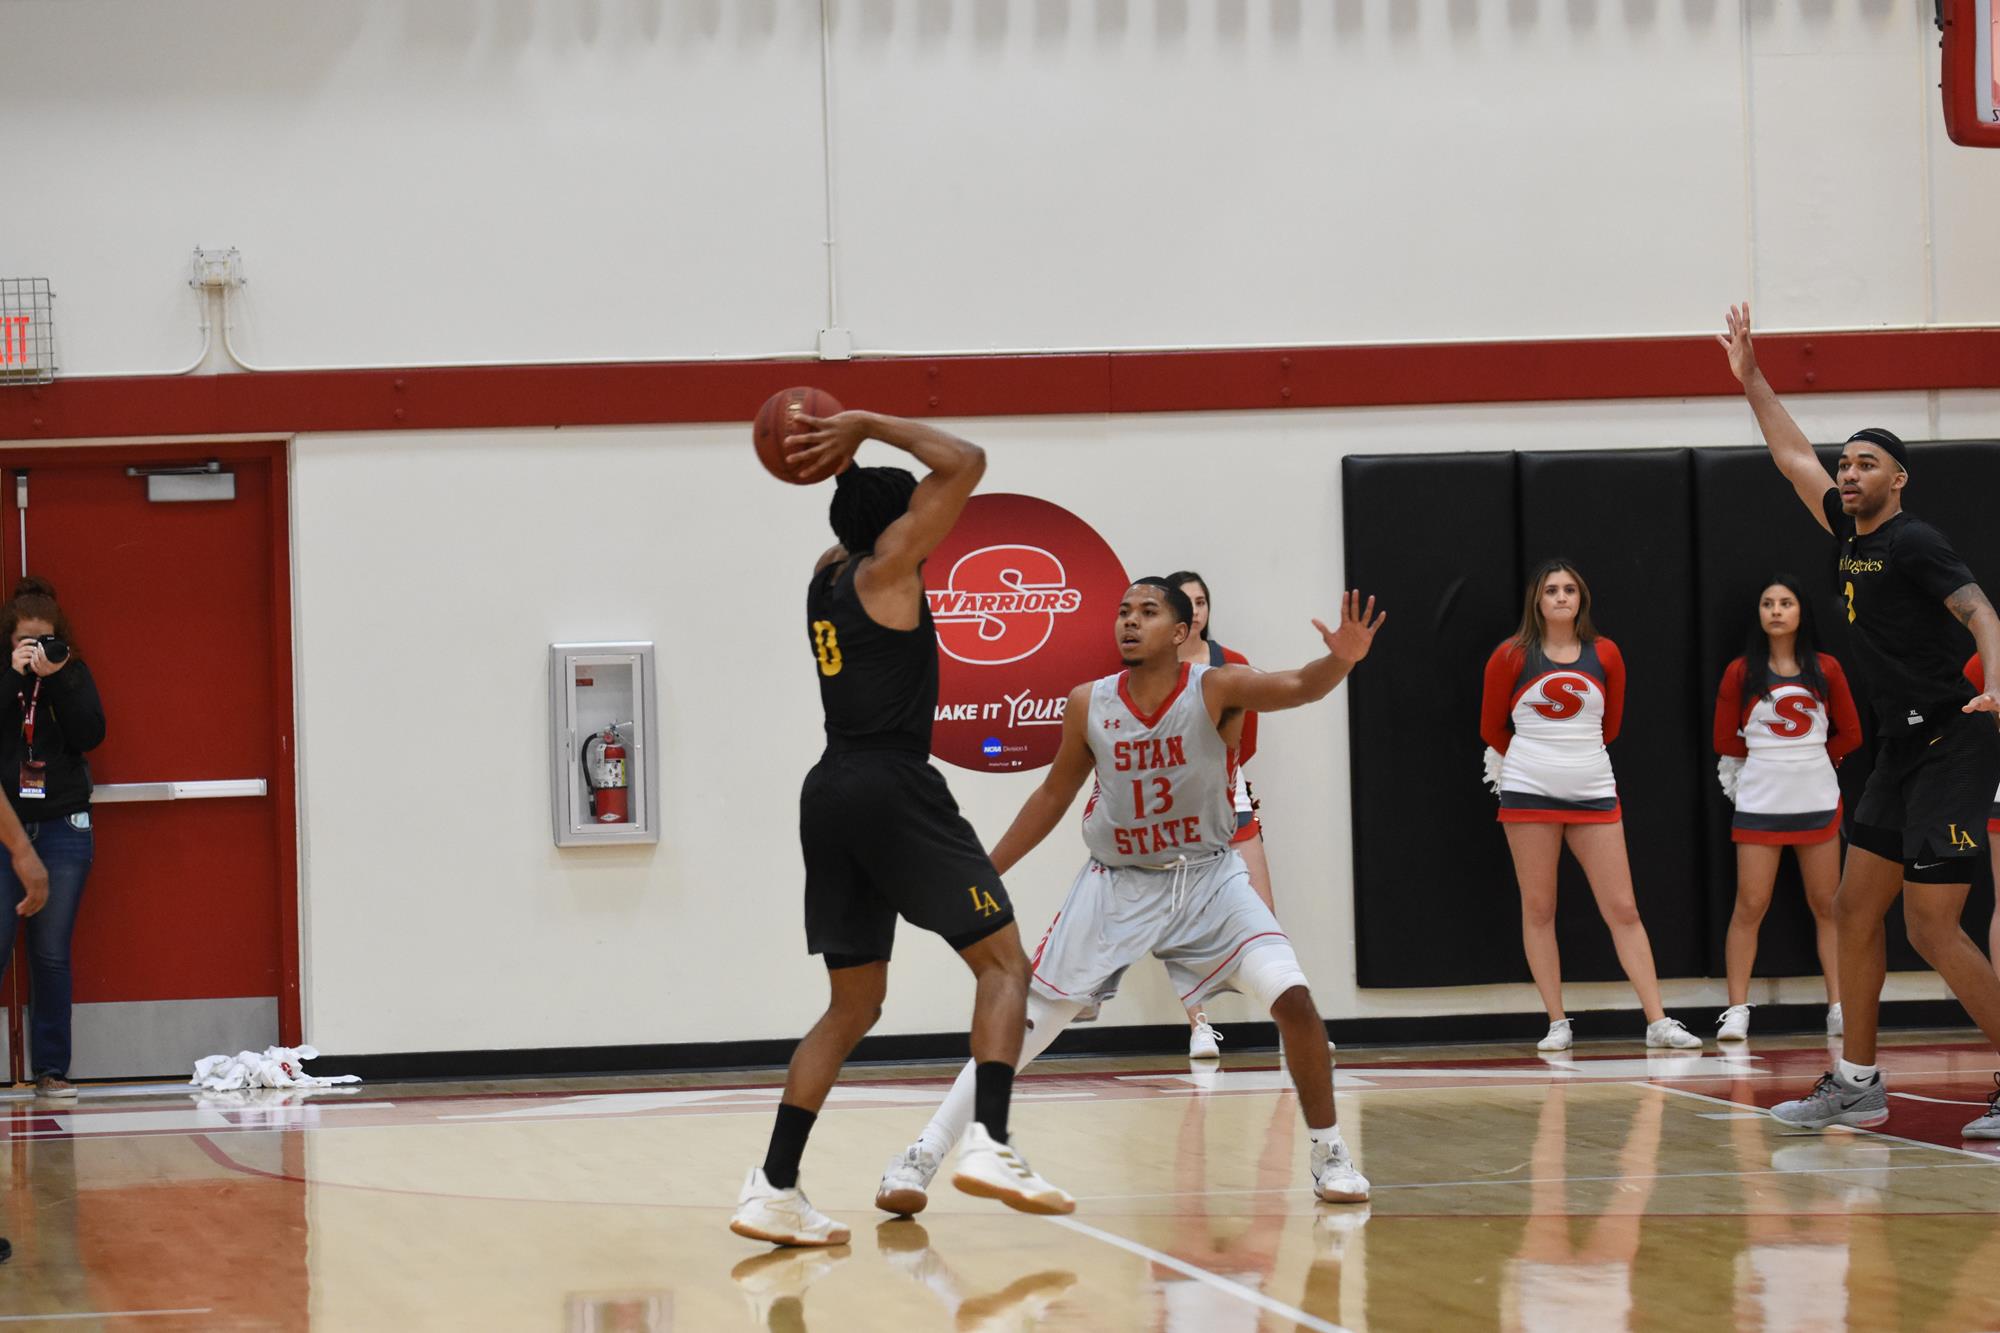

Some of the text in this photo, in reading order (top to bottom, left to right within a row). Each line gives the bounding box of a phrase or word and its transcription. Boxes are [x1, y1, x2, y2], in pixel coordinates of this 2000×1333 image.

[0, 316, 30, 363] IT
[927, 590, 1081, 615] WARRIORS
[982, 703, 1002, 720] IT
[983, 745, 1002, 753] NCAA
[1114, 736, 1187, 771] STAN
[1131, 777, 1174, 820] 13
[1114, 816, 1203, 855] STATE
[1948, 823, 1978, 851] LA
[968, 886, 1001, 917] LA
